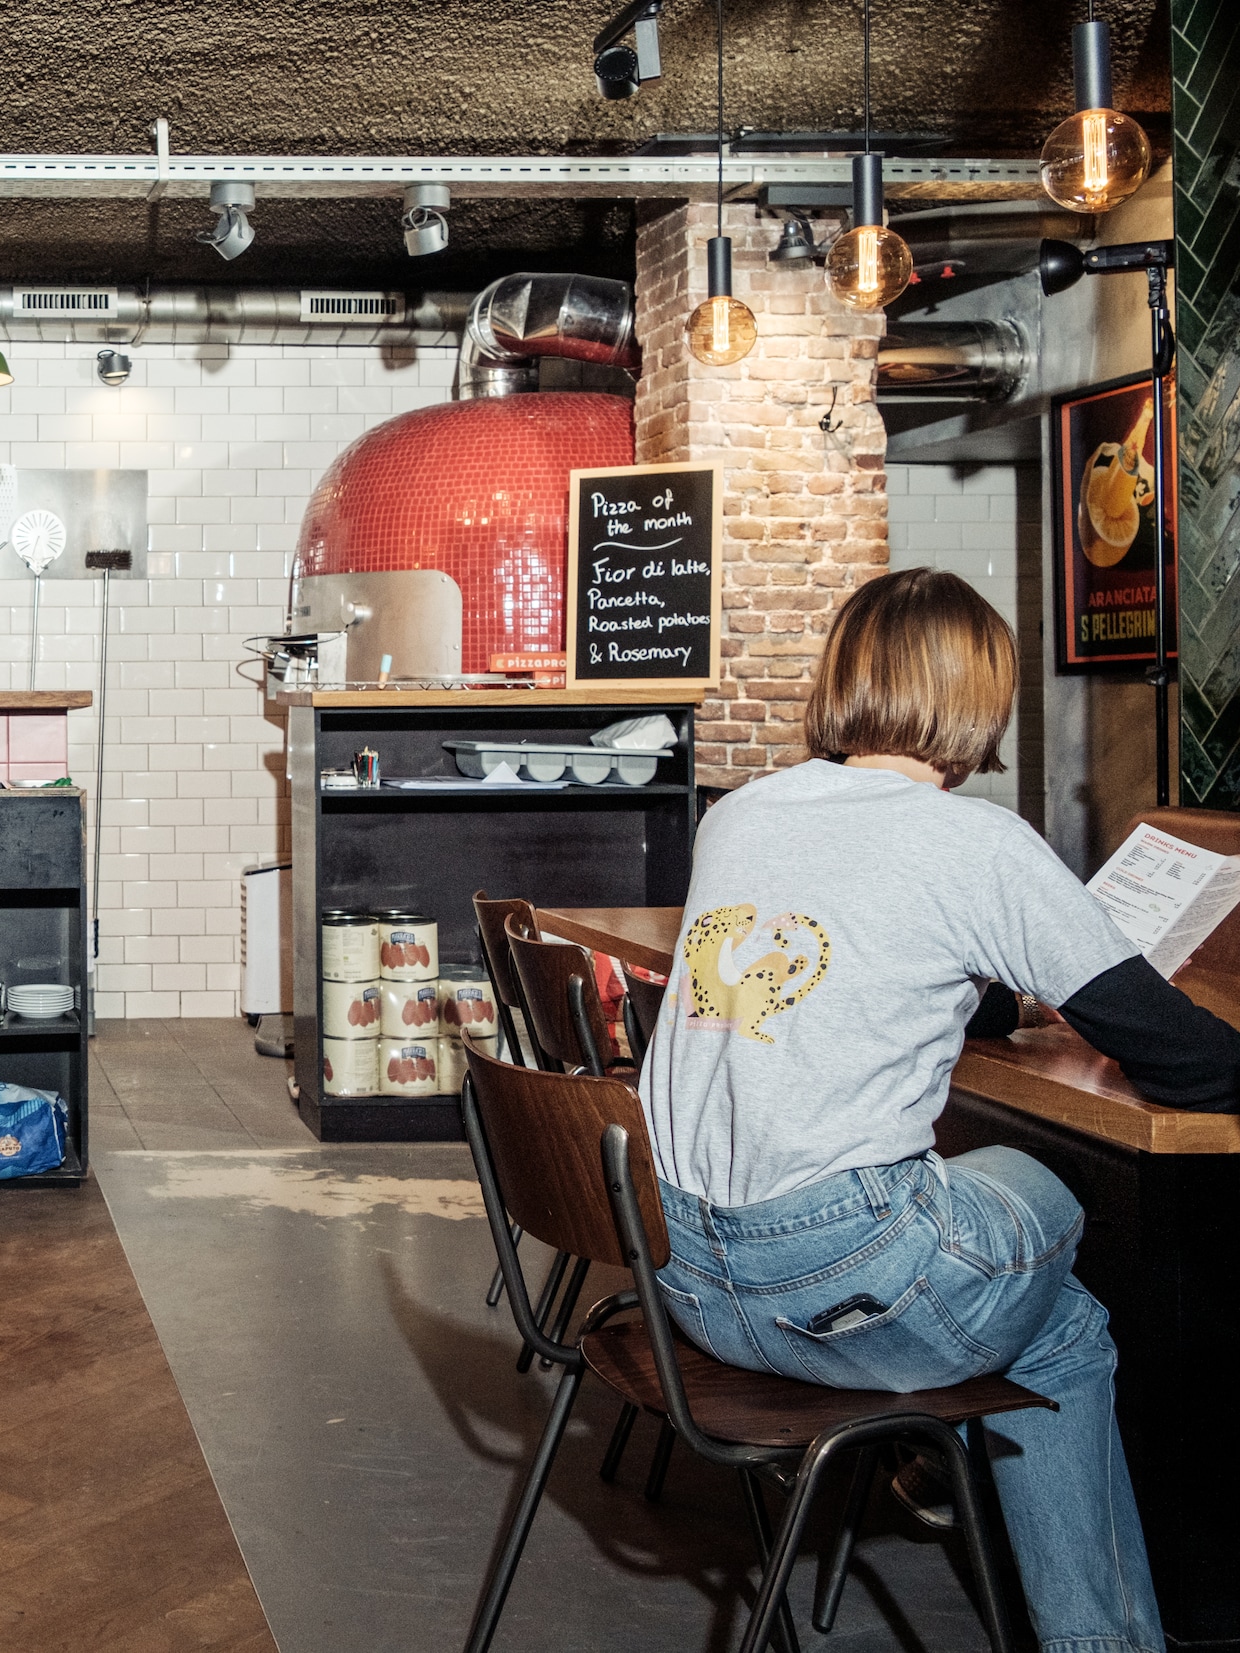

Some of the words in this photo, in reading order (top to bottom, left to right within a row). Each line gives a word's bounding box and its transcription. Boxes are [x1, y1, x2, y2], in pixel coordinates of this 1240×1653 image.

[591, 492, 642, 518] Pizza
[652, 488, 675, 511] of
[607, 519, 633, 537] the
[644, 511, 693, 531] month
[592, 557, 636, 585] Fior
[642, 560, 665, 579] di
[671, 558, 711, 576] latte,
[587, 588, 666, 610] Pancetta,
[1088, 586, 1157, 607] ARANCIATA
[588, 615, 653, 633] Roasted
[658, 612, 711, 634] potatoes
[1081, 615, 1089, 642] S
[1092, 609, 1156, 641] PELLEGRIN
[589, 642, 603, 665] &
[608, 641, 693, 667] Rosemary
[1144, 833, 1174, 850] DRINKS
[1174, 847, 1198, 859] MENU
